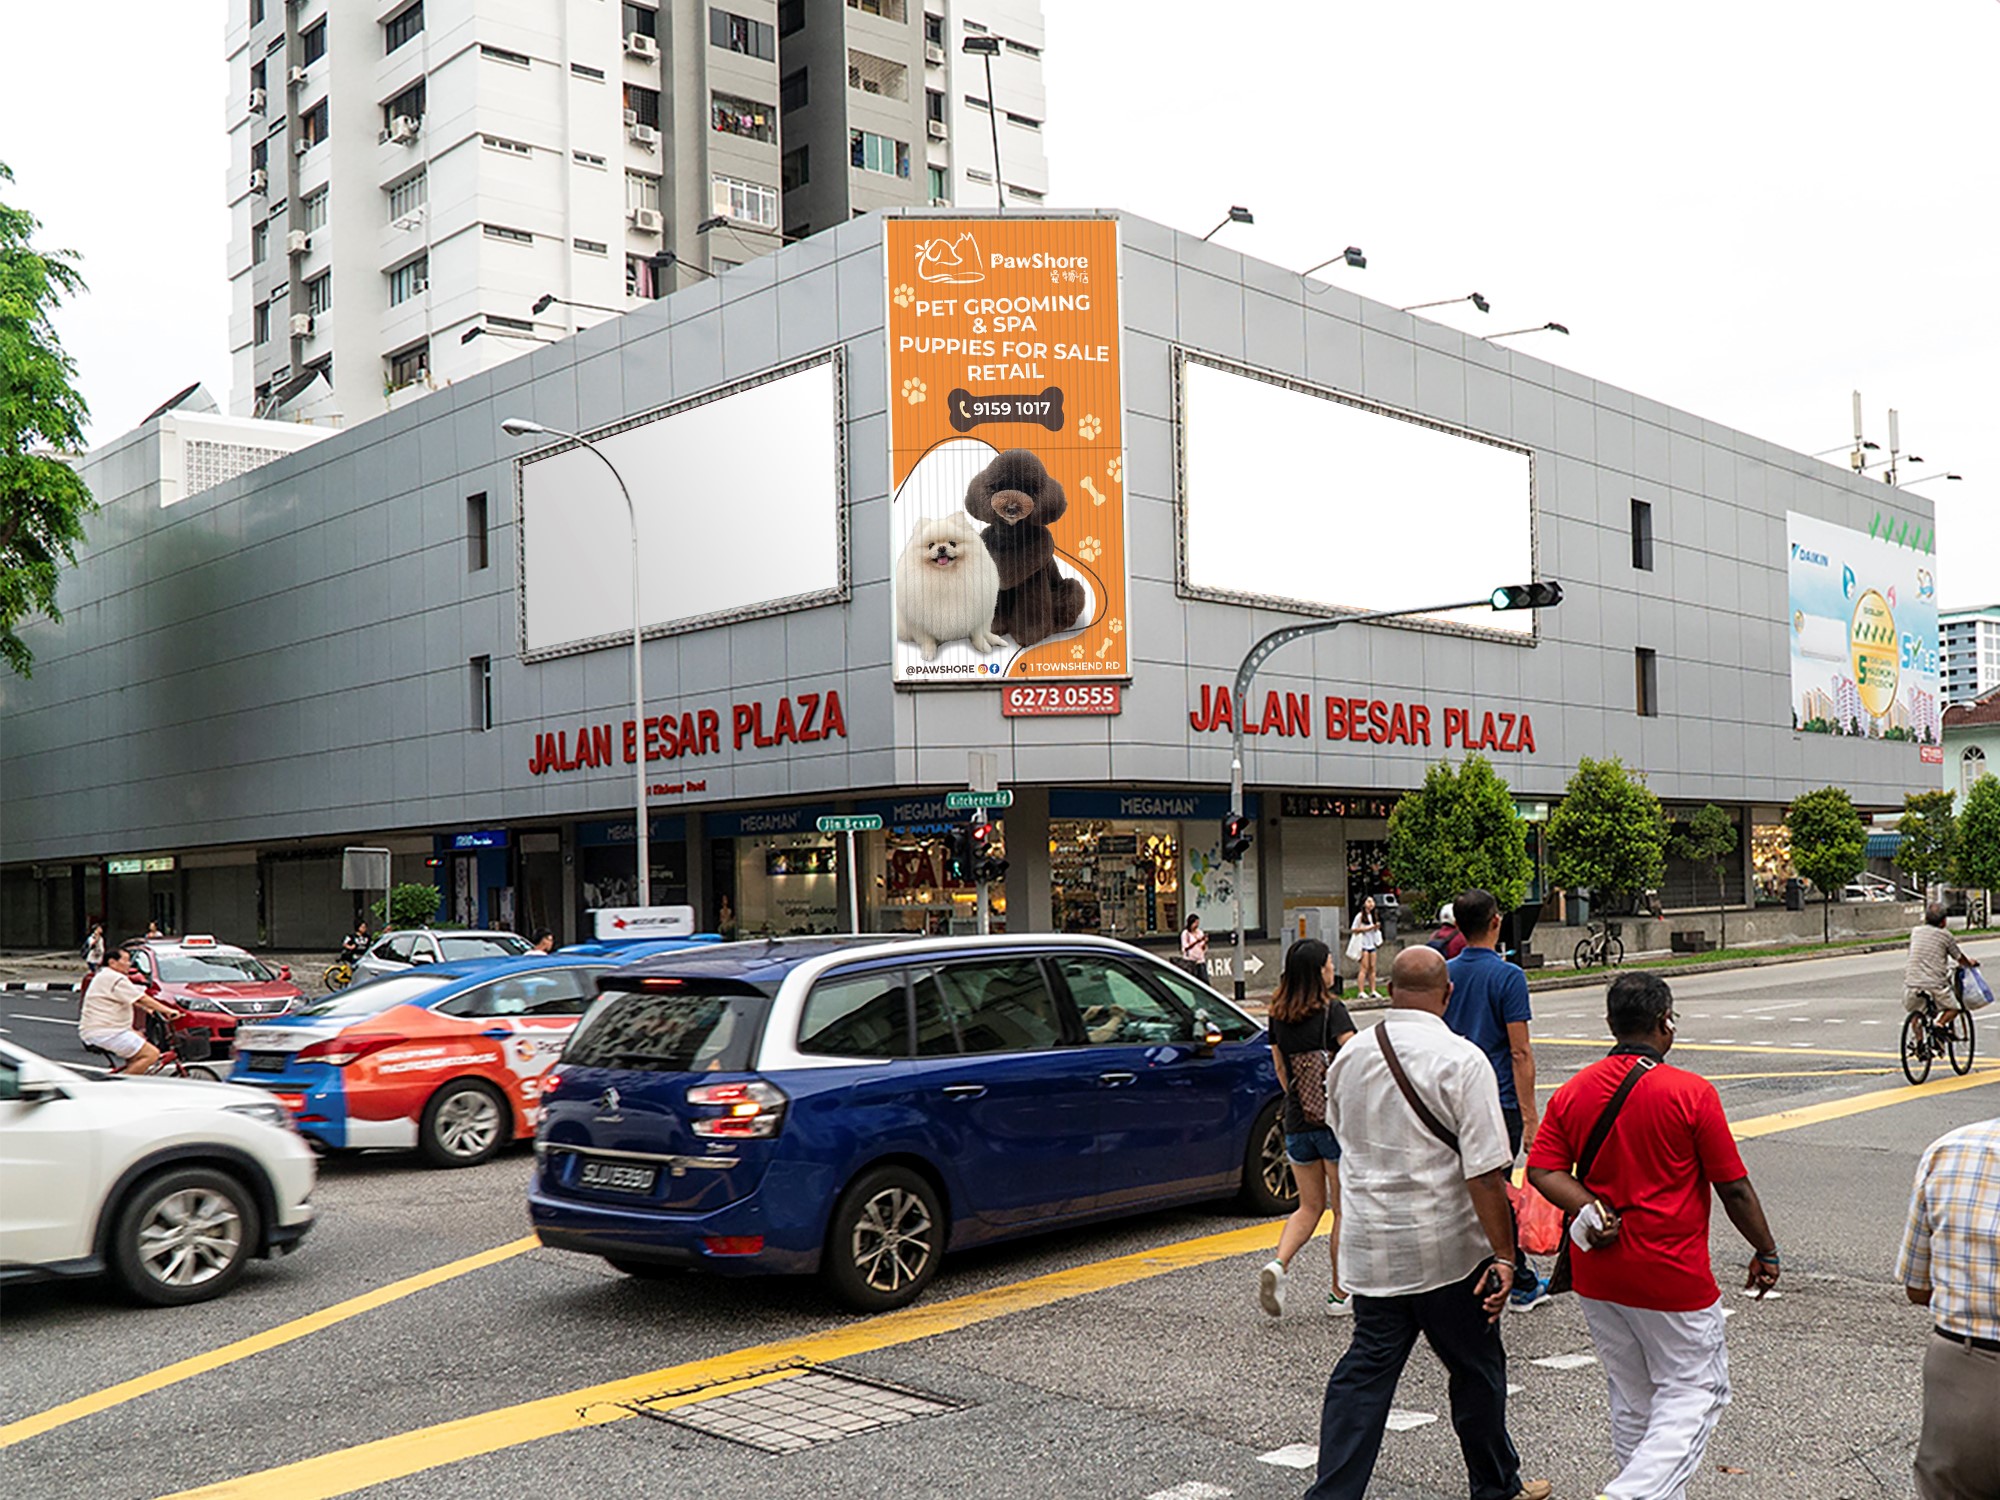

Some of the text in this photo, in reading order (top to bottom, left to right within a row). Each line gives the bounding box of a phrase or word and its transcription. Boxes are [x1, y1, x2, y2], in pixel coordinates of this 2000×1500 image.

[990, 253, 1089, 269] PawShore
[915, 294, 1090, 317] PET GROOMING
[972, 315, 1037, 334] & SPA
[899, 336, 1110, 362] PUPPIES FOR SALE
[967, 363, 1045, 381] RETAIL
[973, 401, 1051, 416] 9159 1017
[1799, 548, 1829, 567] DAIKIN
[905, 664, 975, 676] @PAWSHORE
[1030, 661, 1121, 672] 1 TOWNSHEND RD
[1010, 687, 1115, 706] 6273 0555
[1190, 683, 1537, 753] JALAN BESAR PLAZA
[528, 689, 848, 776] JALAN BESAR PLAZA
[950, 793, 1007, 806] Kitchener Rd
[1120, 797, 1195, 815] MEGAMAN
[607, 822, 656, 840] MEGAN
[740, 813, 798, 832] MEGAMAN
[845, 818, 877, 829] Besar
[892, 848, 978, 889] SAL
